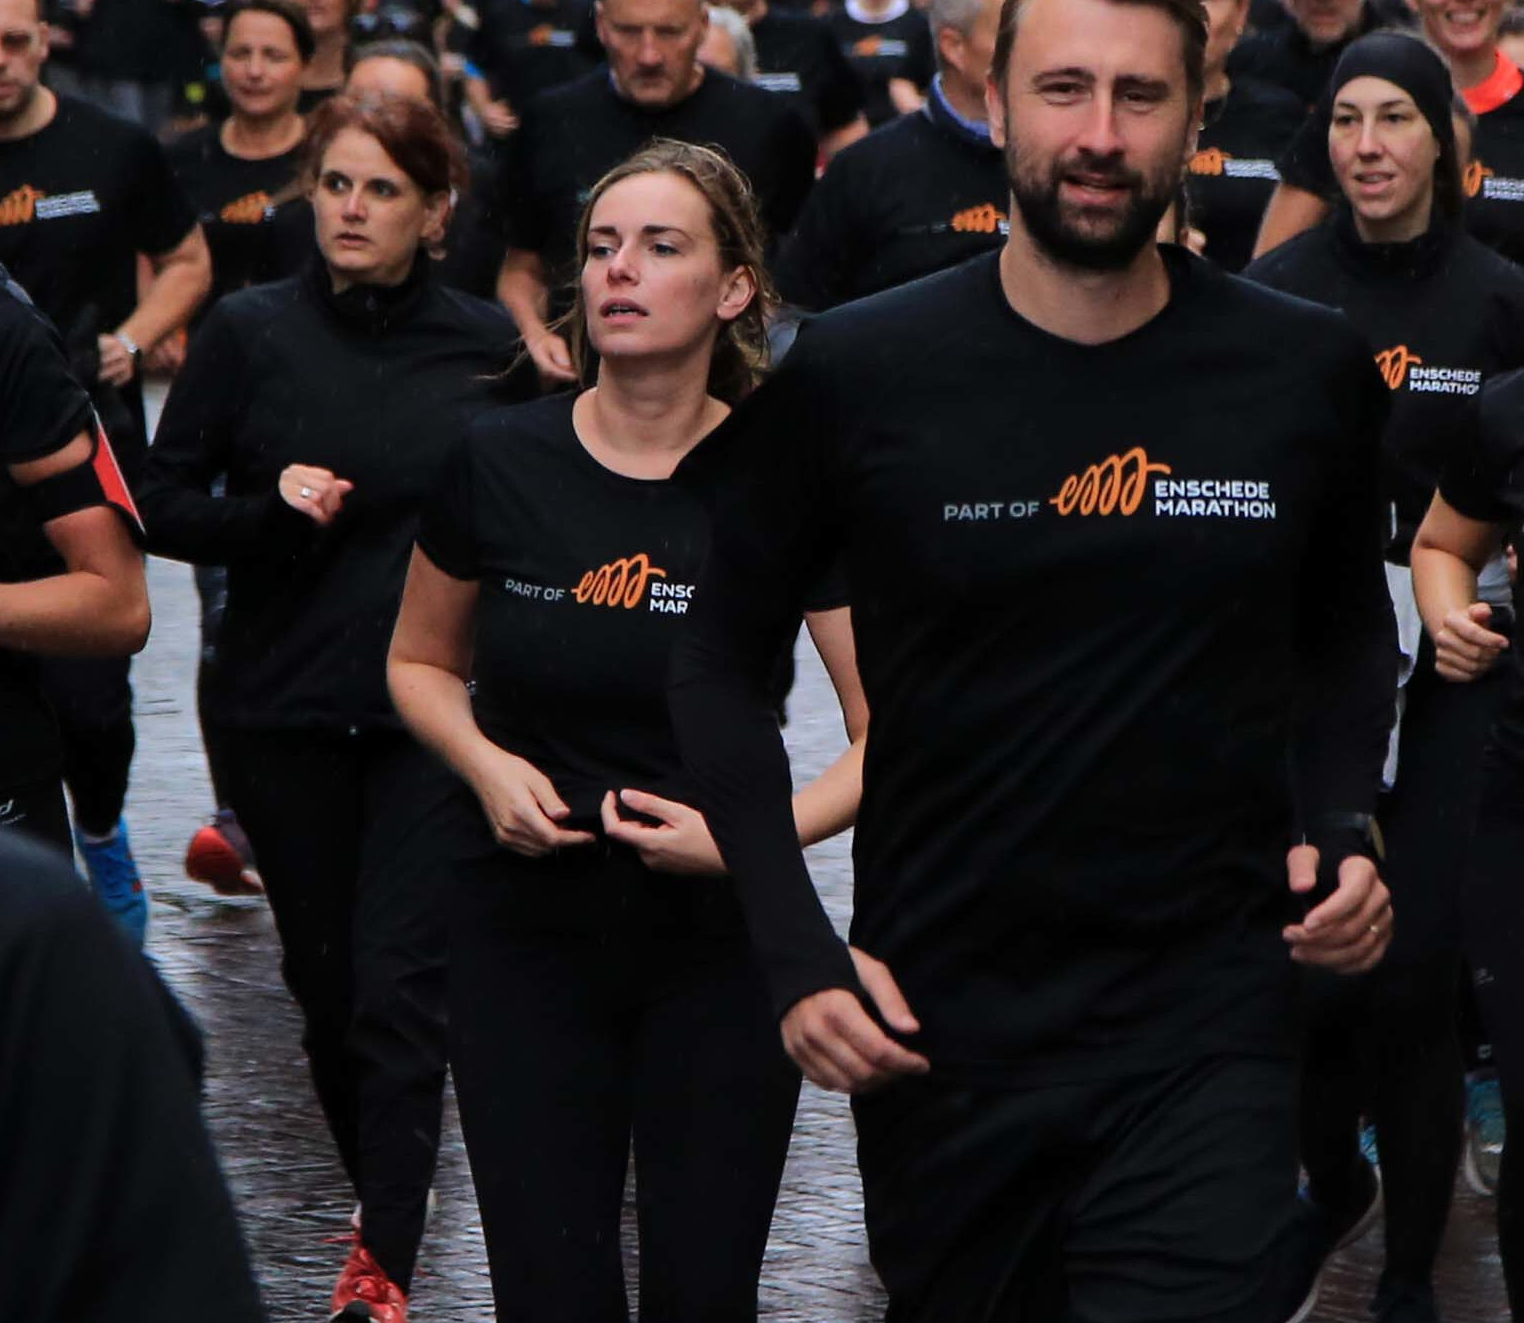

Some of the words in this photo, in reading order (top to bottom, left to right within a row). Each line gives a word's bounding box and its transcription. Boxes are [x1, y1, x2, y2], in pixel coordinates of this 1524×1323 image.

[1410, 367, 1481, 383] ENSCHEDE
[1155, 480, 1270, 500] ENSCHEDE
[944, 501, 1004, 522] PART
[1009, 501, 1039, 519] OF
[1155, 499, 1276, 520] MARATHON
[505, 579, 542, 599] PART
[543, 587, 566, 602] OF
[651, 582, 695, 599] ENSC
[649, 599, 689, 614] MAR
